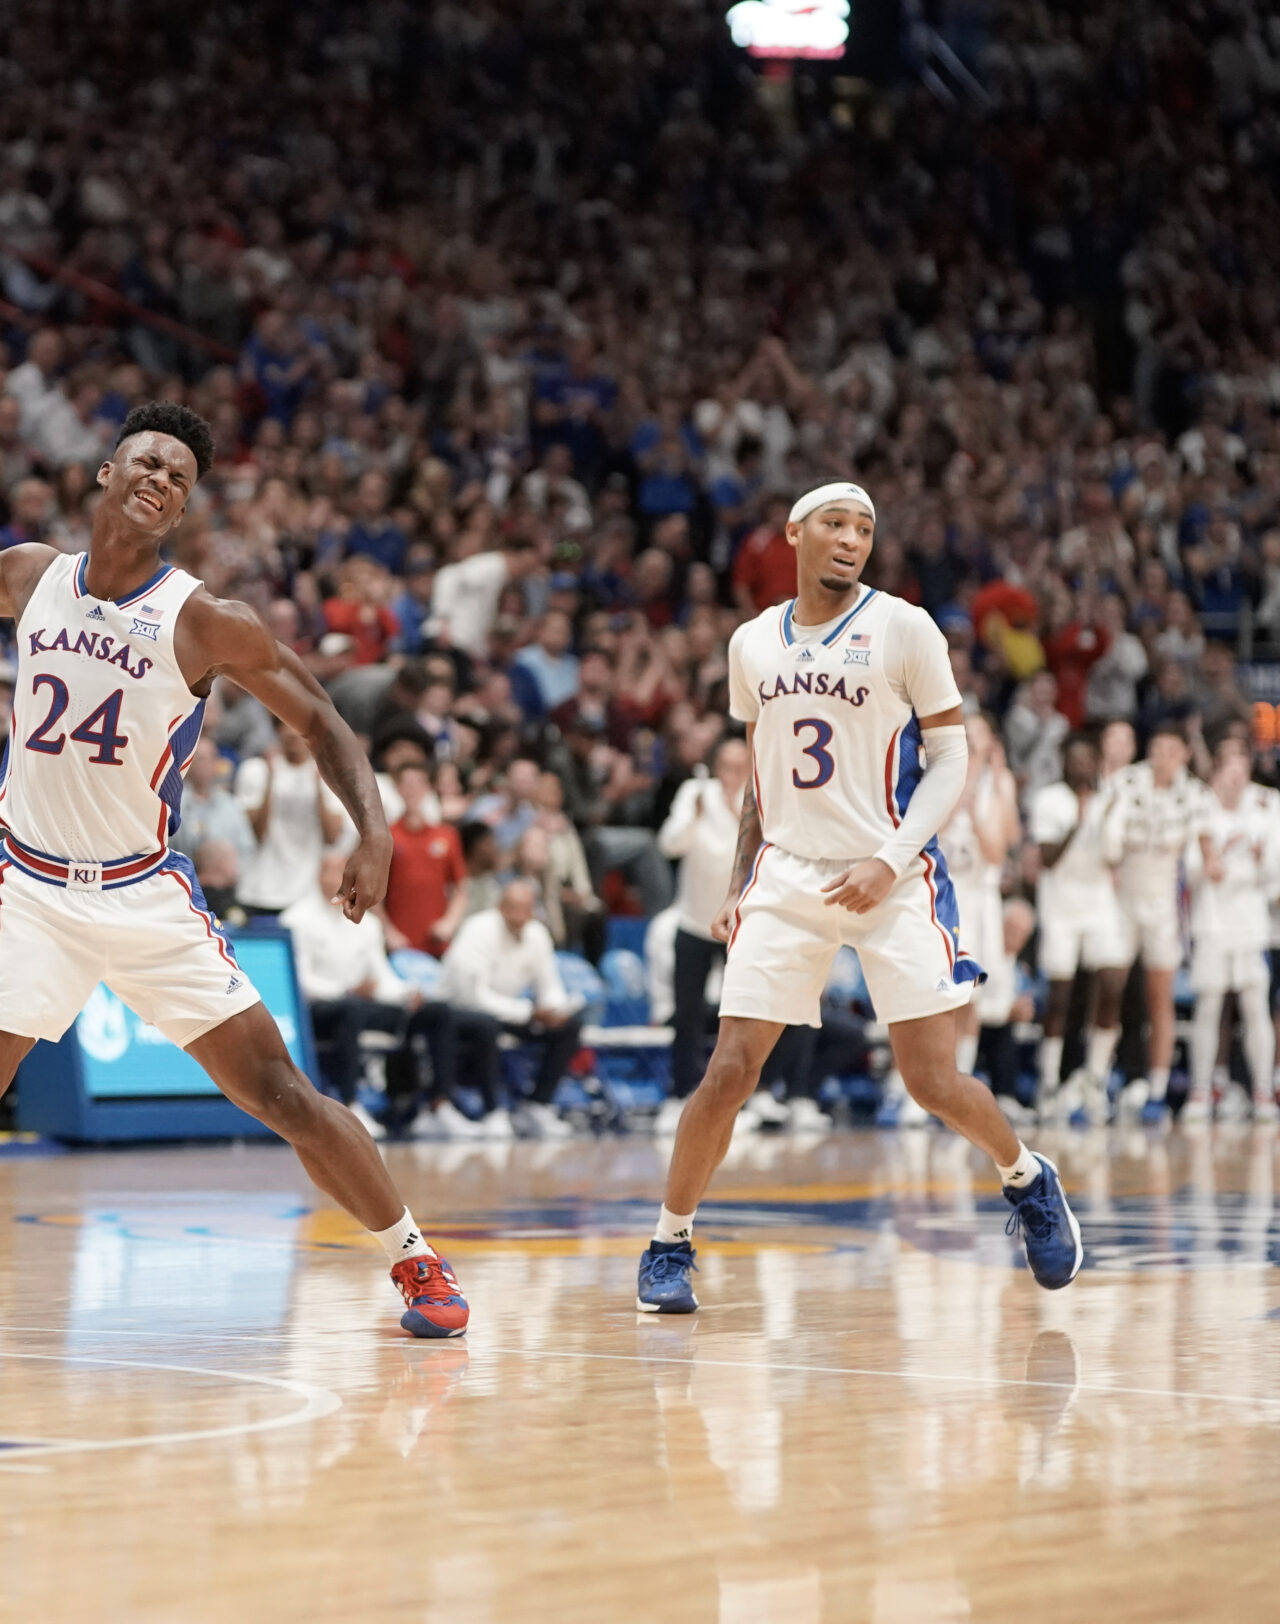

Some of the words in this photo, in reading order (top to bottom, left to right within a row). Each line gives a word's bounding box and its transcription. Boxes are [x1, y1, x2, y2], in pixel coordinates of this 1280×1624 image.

[29, 627, 154, 679] KANSAS
[758, 671, 870, 707] KANSAS
[25, 673, 129, 766] 24
[792, 717, 835, 790] 3
[73, 868, 97, 884] KU
